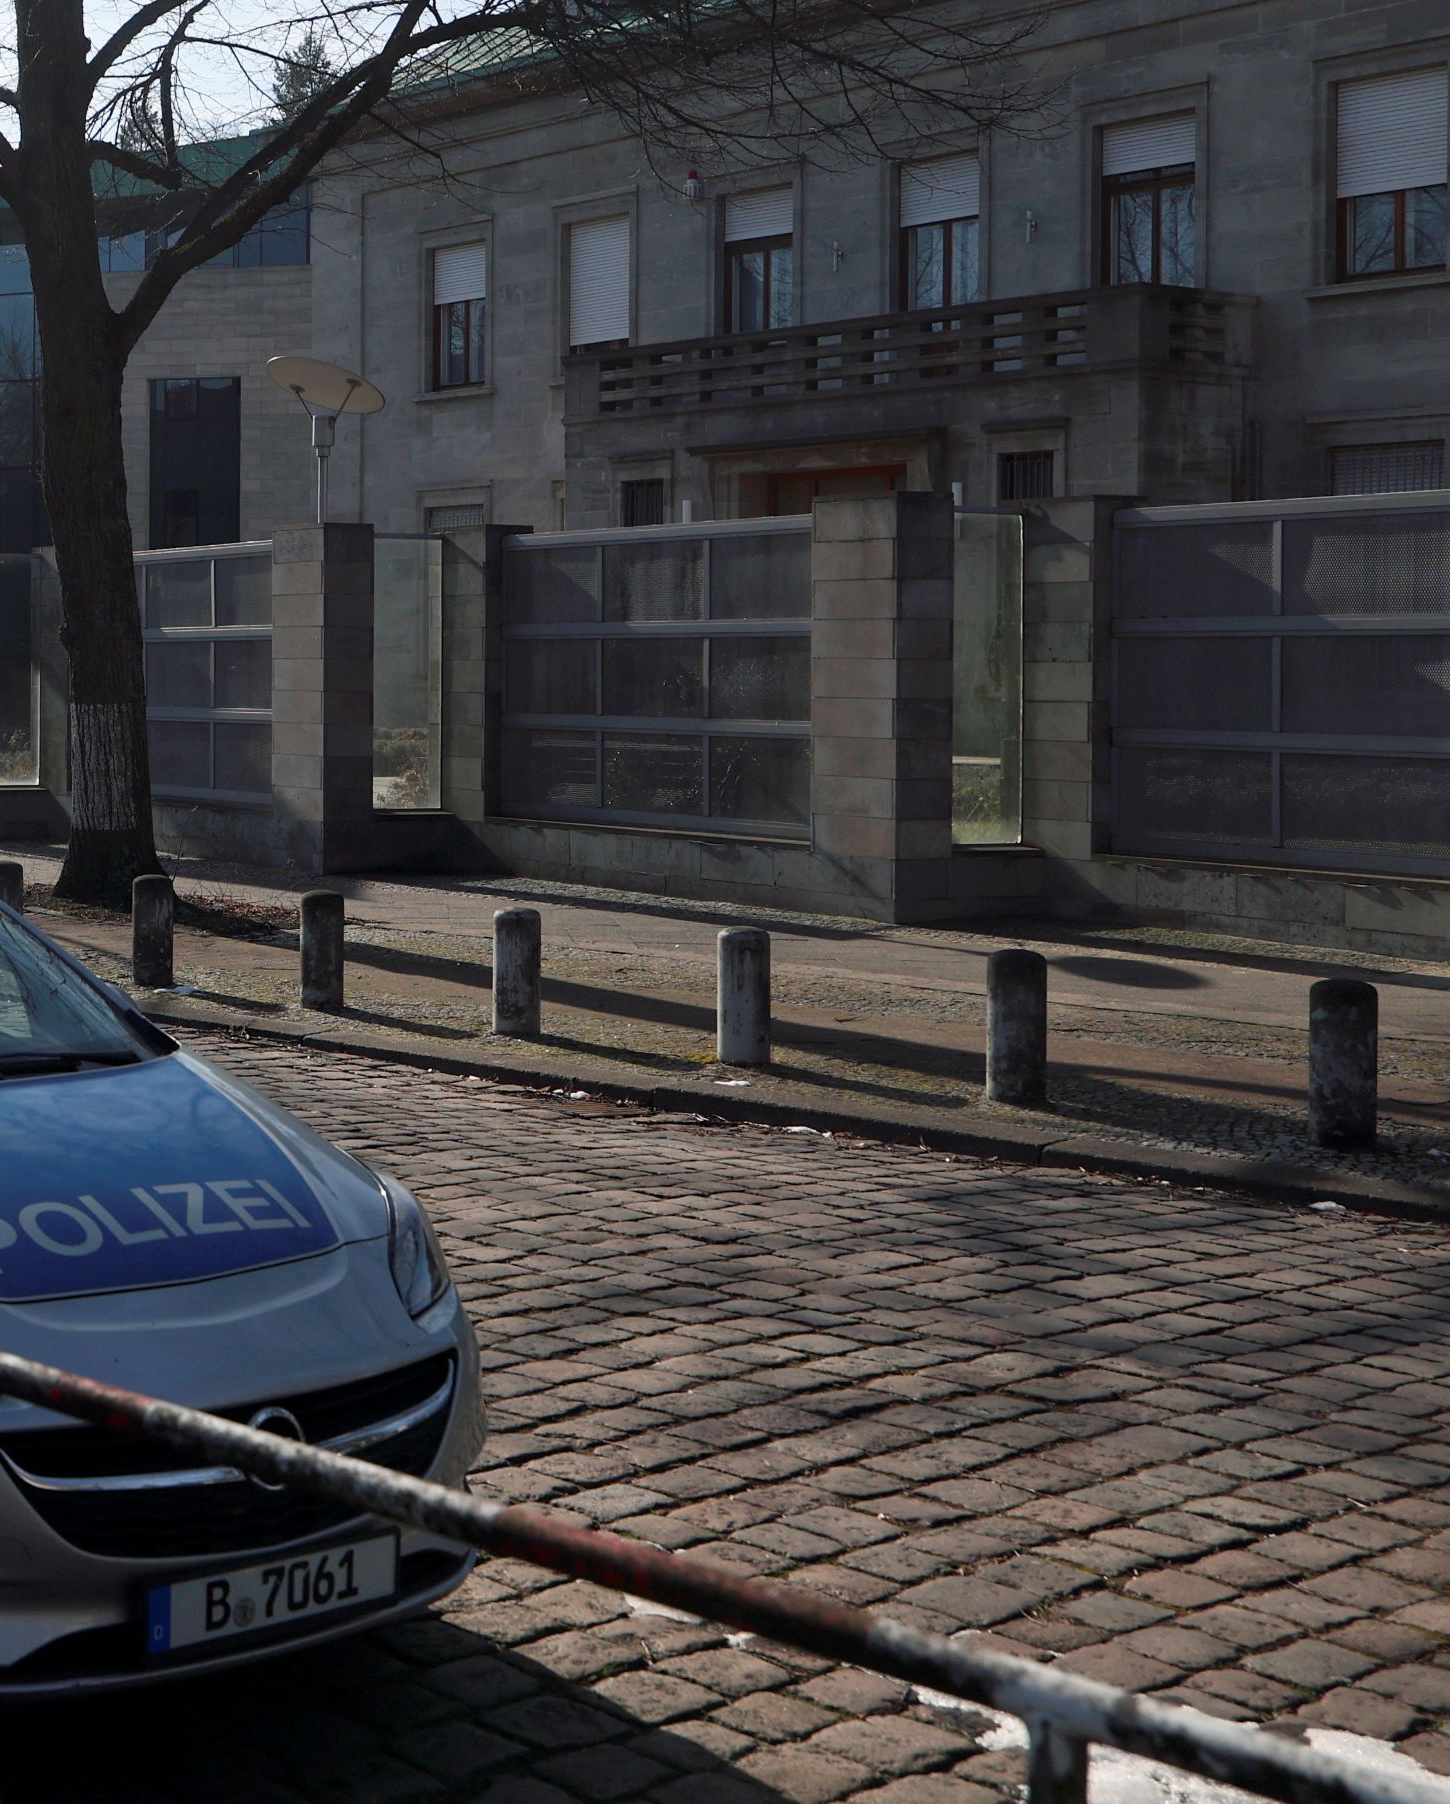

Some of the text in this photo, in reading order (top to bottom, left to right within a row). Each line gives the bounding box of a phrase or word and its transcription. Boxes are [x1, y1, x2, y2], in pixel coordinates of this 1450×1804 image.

[153, 1549, 359, 1640] D B 7061
